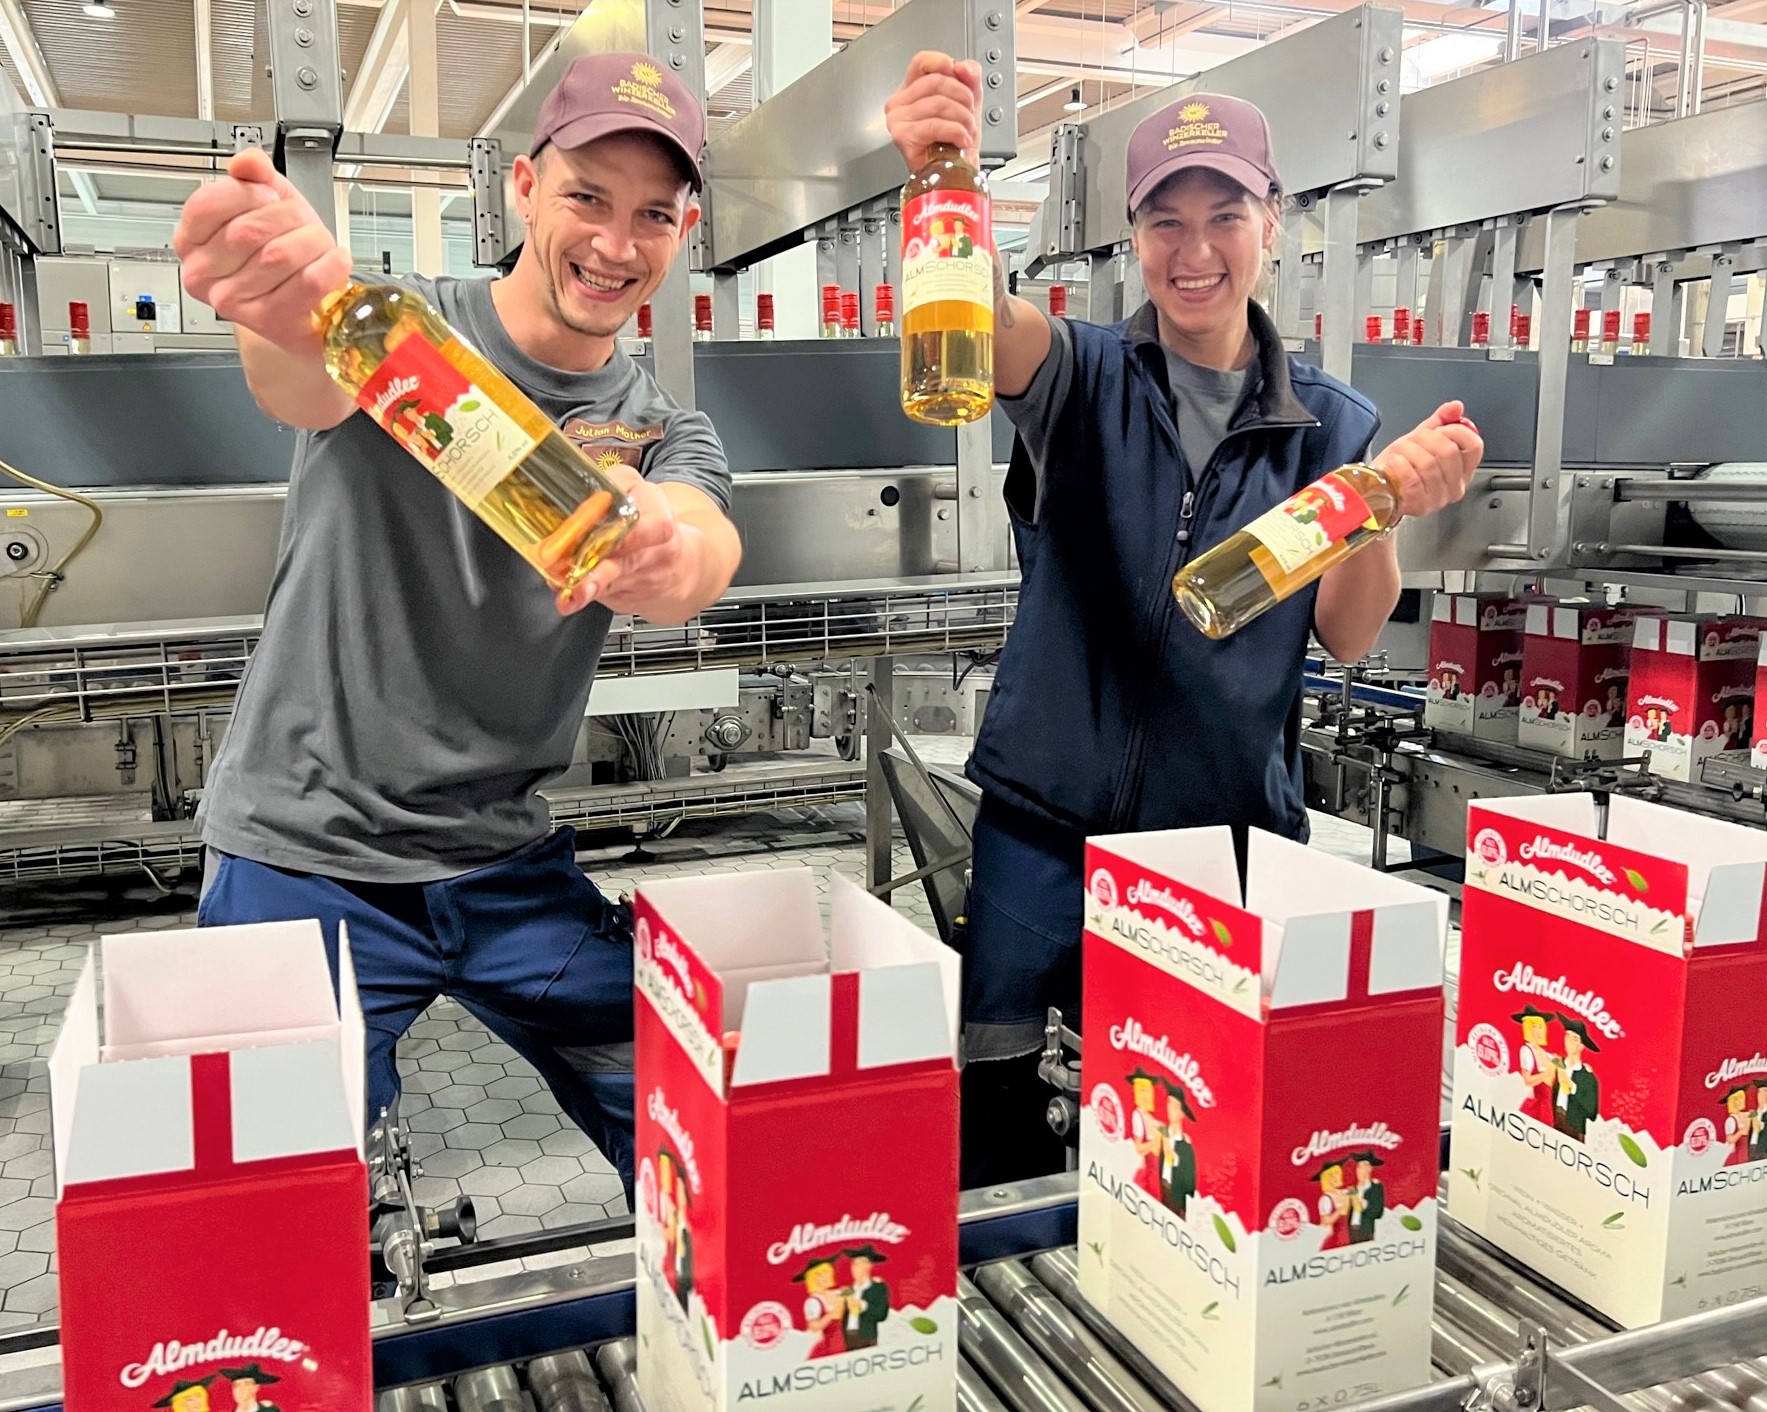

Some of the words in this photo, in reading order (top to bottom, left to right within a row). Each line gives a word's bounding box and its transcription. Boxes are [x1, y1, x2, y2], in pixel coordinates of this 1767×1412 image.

[913, 200, 979, 226] Almdudler
[1519, 835, 1615, 885] Almdudler
[1126, 878, 1206, 936] Almdudler
[1499, 872, 1639, 931] ALMSCHORSCH
[1112, 918, 1225, 989] ALMSCHORSCH
[1493, 961, 1622, 1039] Almdudler
[1109, 1017, 1214, 1108] Almdudler
[1291, 1122, 1402, 1166] Almdudler
[1462, 1094, 1650, 1209] ALMSCHORSCH
[767, 1212, 909, 1265] Almdudler
[1087, 1161, 1240, 1300] ALMSCHORSCH
[1264, 1238, 1426, 1288] ALMSCHORSCH
[120, 1326, 305, 1388] Almdudler
[737, 1342, 943, 1403] ALMSCHORSCH
